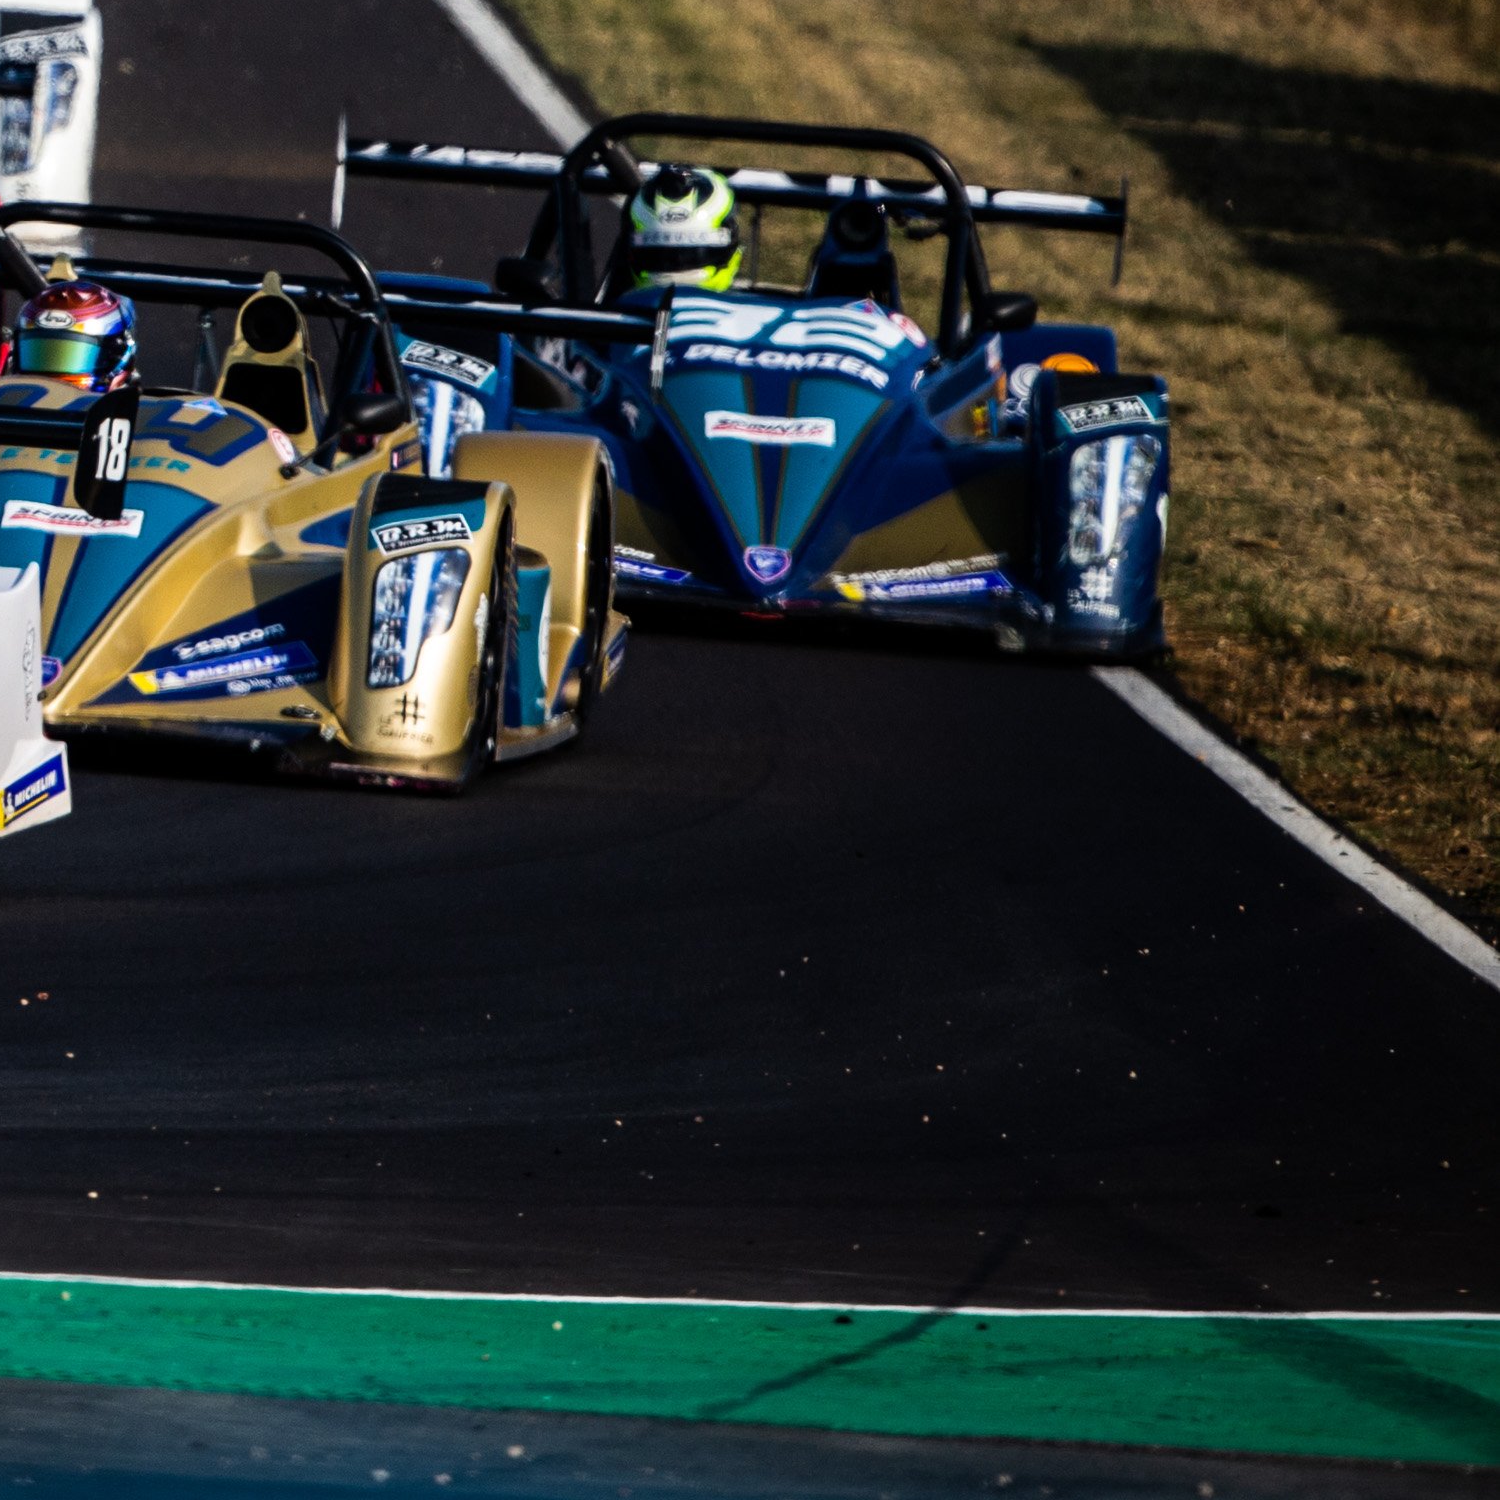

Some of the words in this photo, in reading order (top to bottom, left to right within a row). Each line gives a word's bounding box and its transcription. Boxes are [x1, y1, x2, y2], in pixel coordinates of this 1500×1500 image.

[665, 297, 905, 361] 32
[684, 344, 890, 390] DELOMIER
[95, 418, 131, 481] 18
[14, 769, 57, 806] MICHELIN
